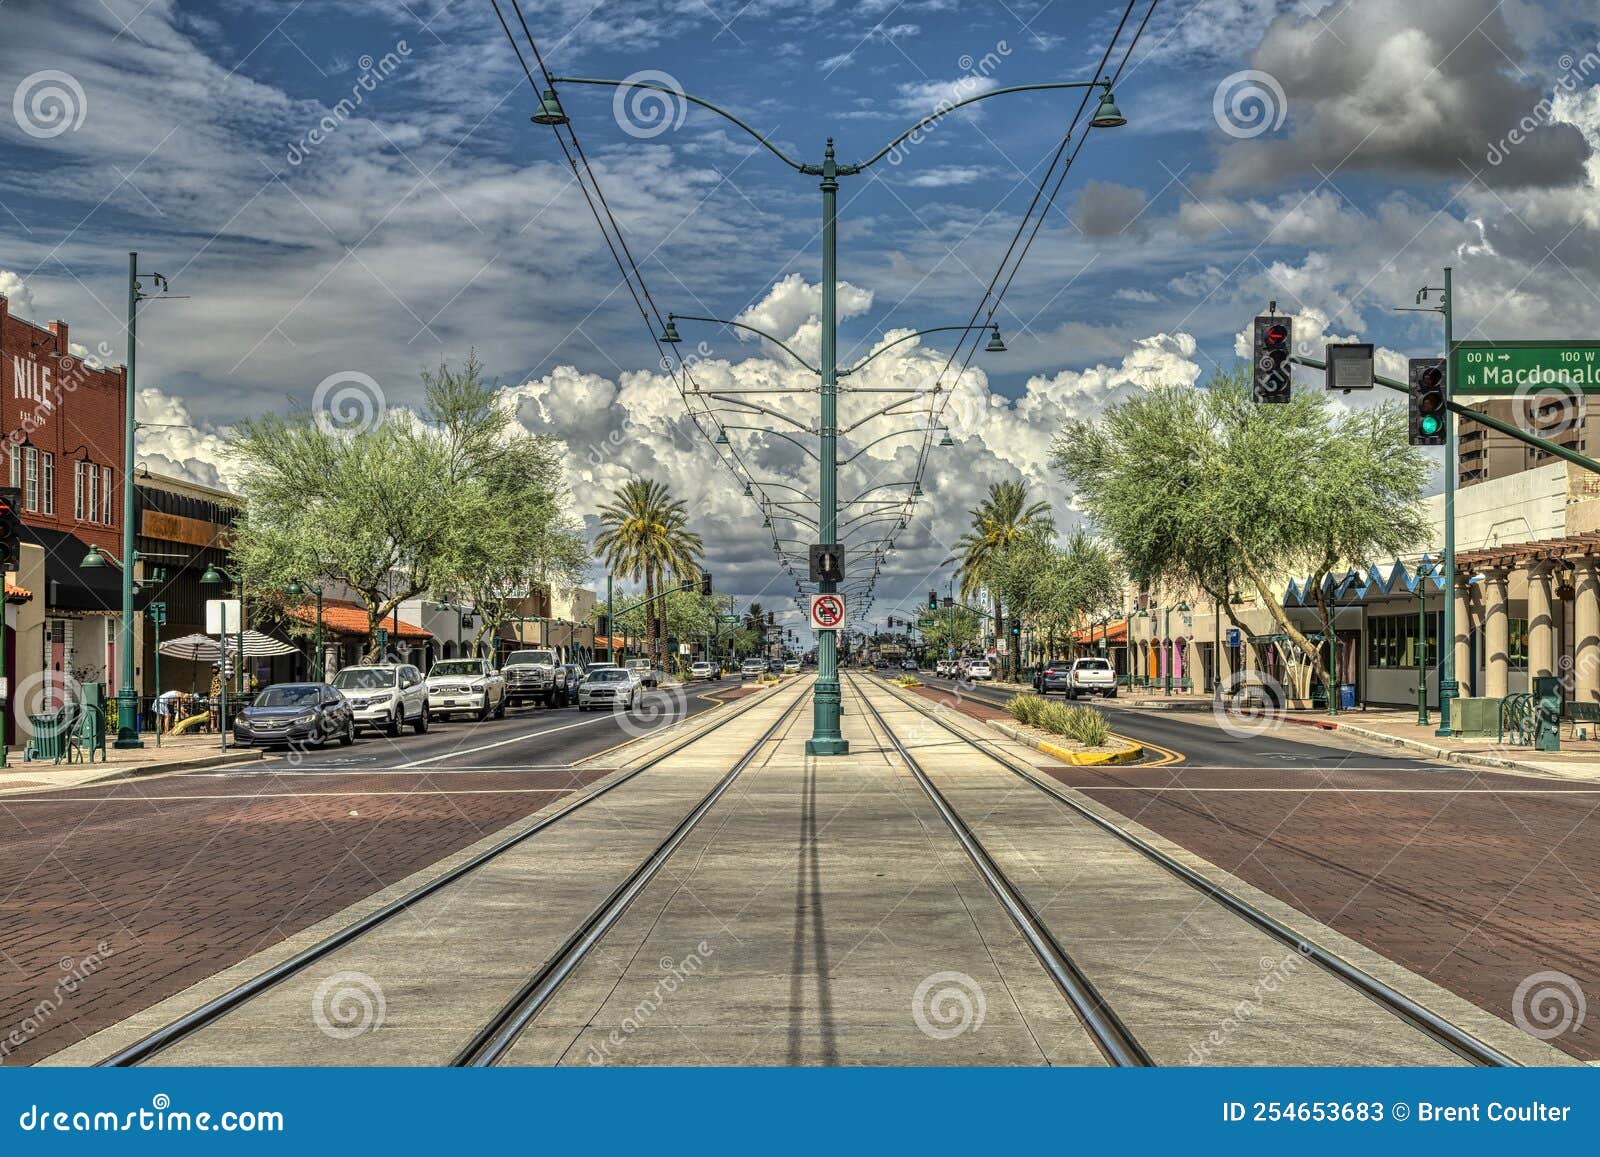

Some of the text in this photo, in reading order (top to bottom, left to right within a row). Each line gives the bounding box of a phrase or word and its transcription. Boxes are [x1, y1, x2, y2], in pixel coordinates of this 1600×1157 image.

[1467, 353, 1494, 362] 00 N
[1560, 352, 1595, 362] 100 W
[14, 355, 51, 410] NILE
[1468, 375, 1476, 385] N
